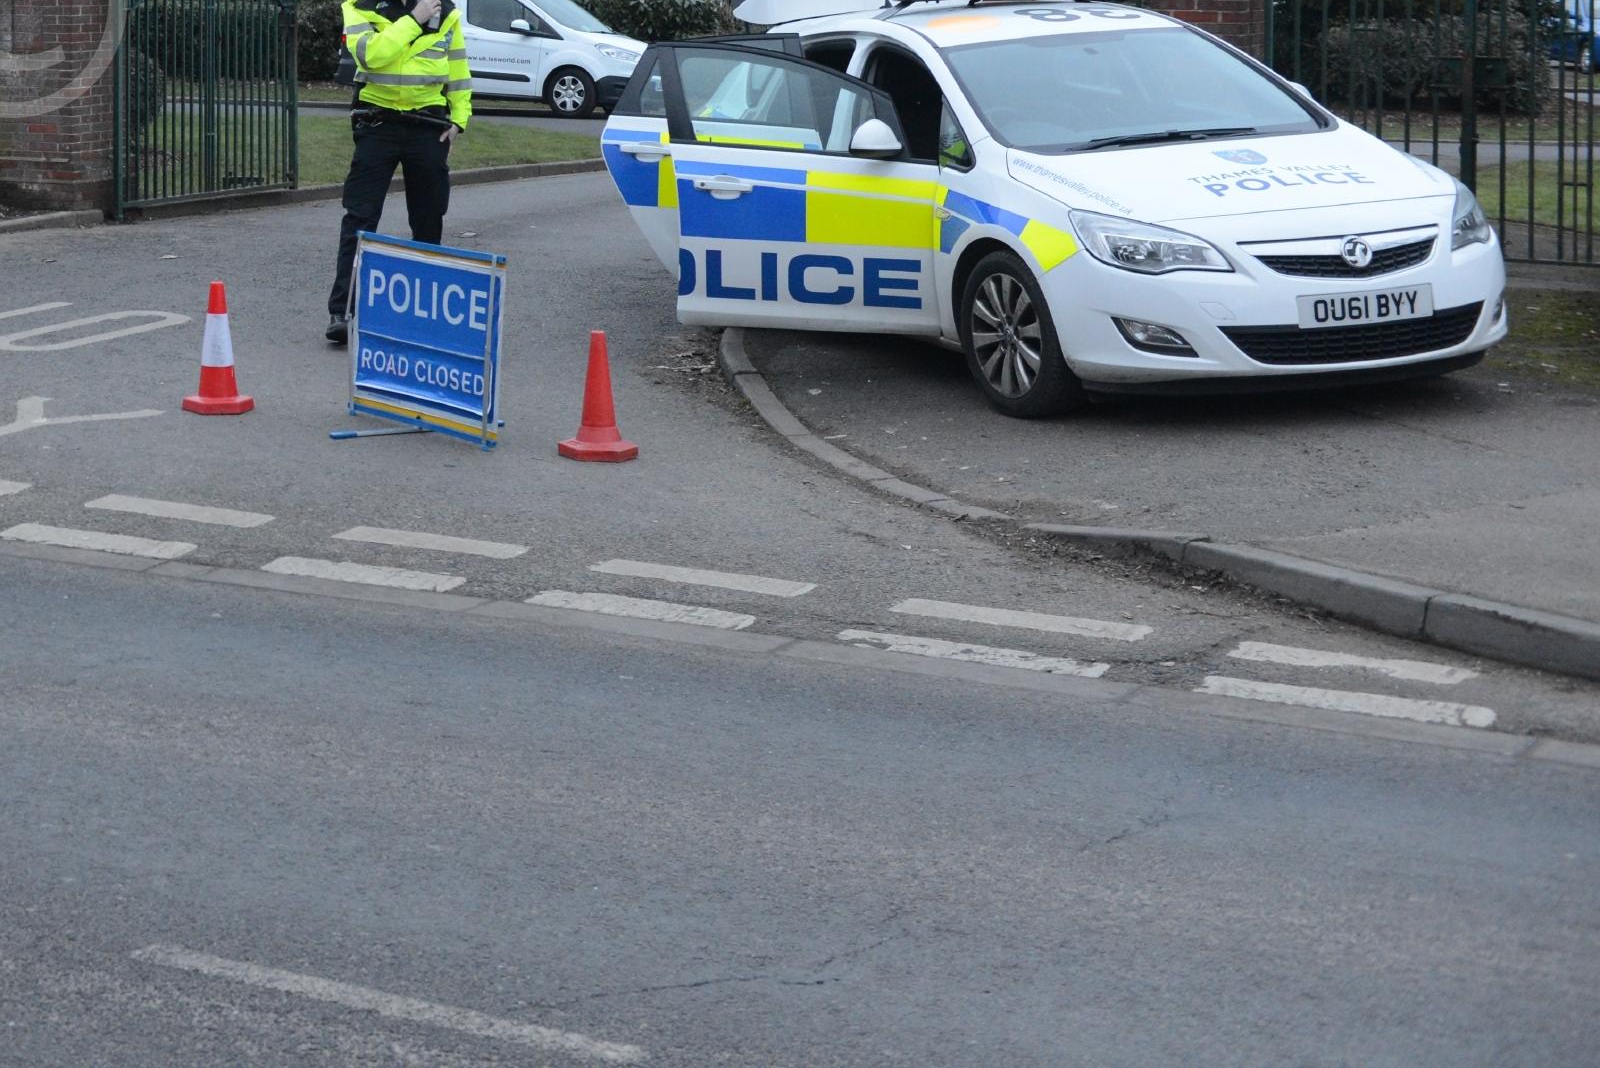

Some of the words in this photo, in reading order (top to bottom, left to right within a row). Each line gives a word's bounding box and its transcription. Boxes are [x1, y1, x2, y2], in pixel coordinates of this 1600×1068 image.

[1188, 167, 1274, 184] THAMES
[1279, 164, 1352, 172] VALLEY
[1203, 172, 1376, 197] POLICE
[679, 248, 922, 309] LICE
[368, 269, 488, 331] POLICE
[1313, 296, 1370, 323] OU61
[1376, 291, 1417, 318] BYY
[361, 348, 409, 377] ROAD
[415, 360, 485, 396] CLOSED
